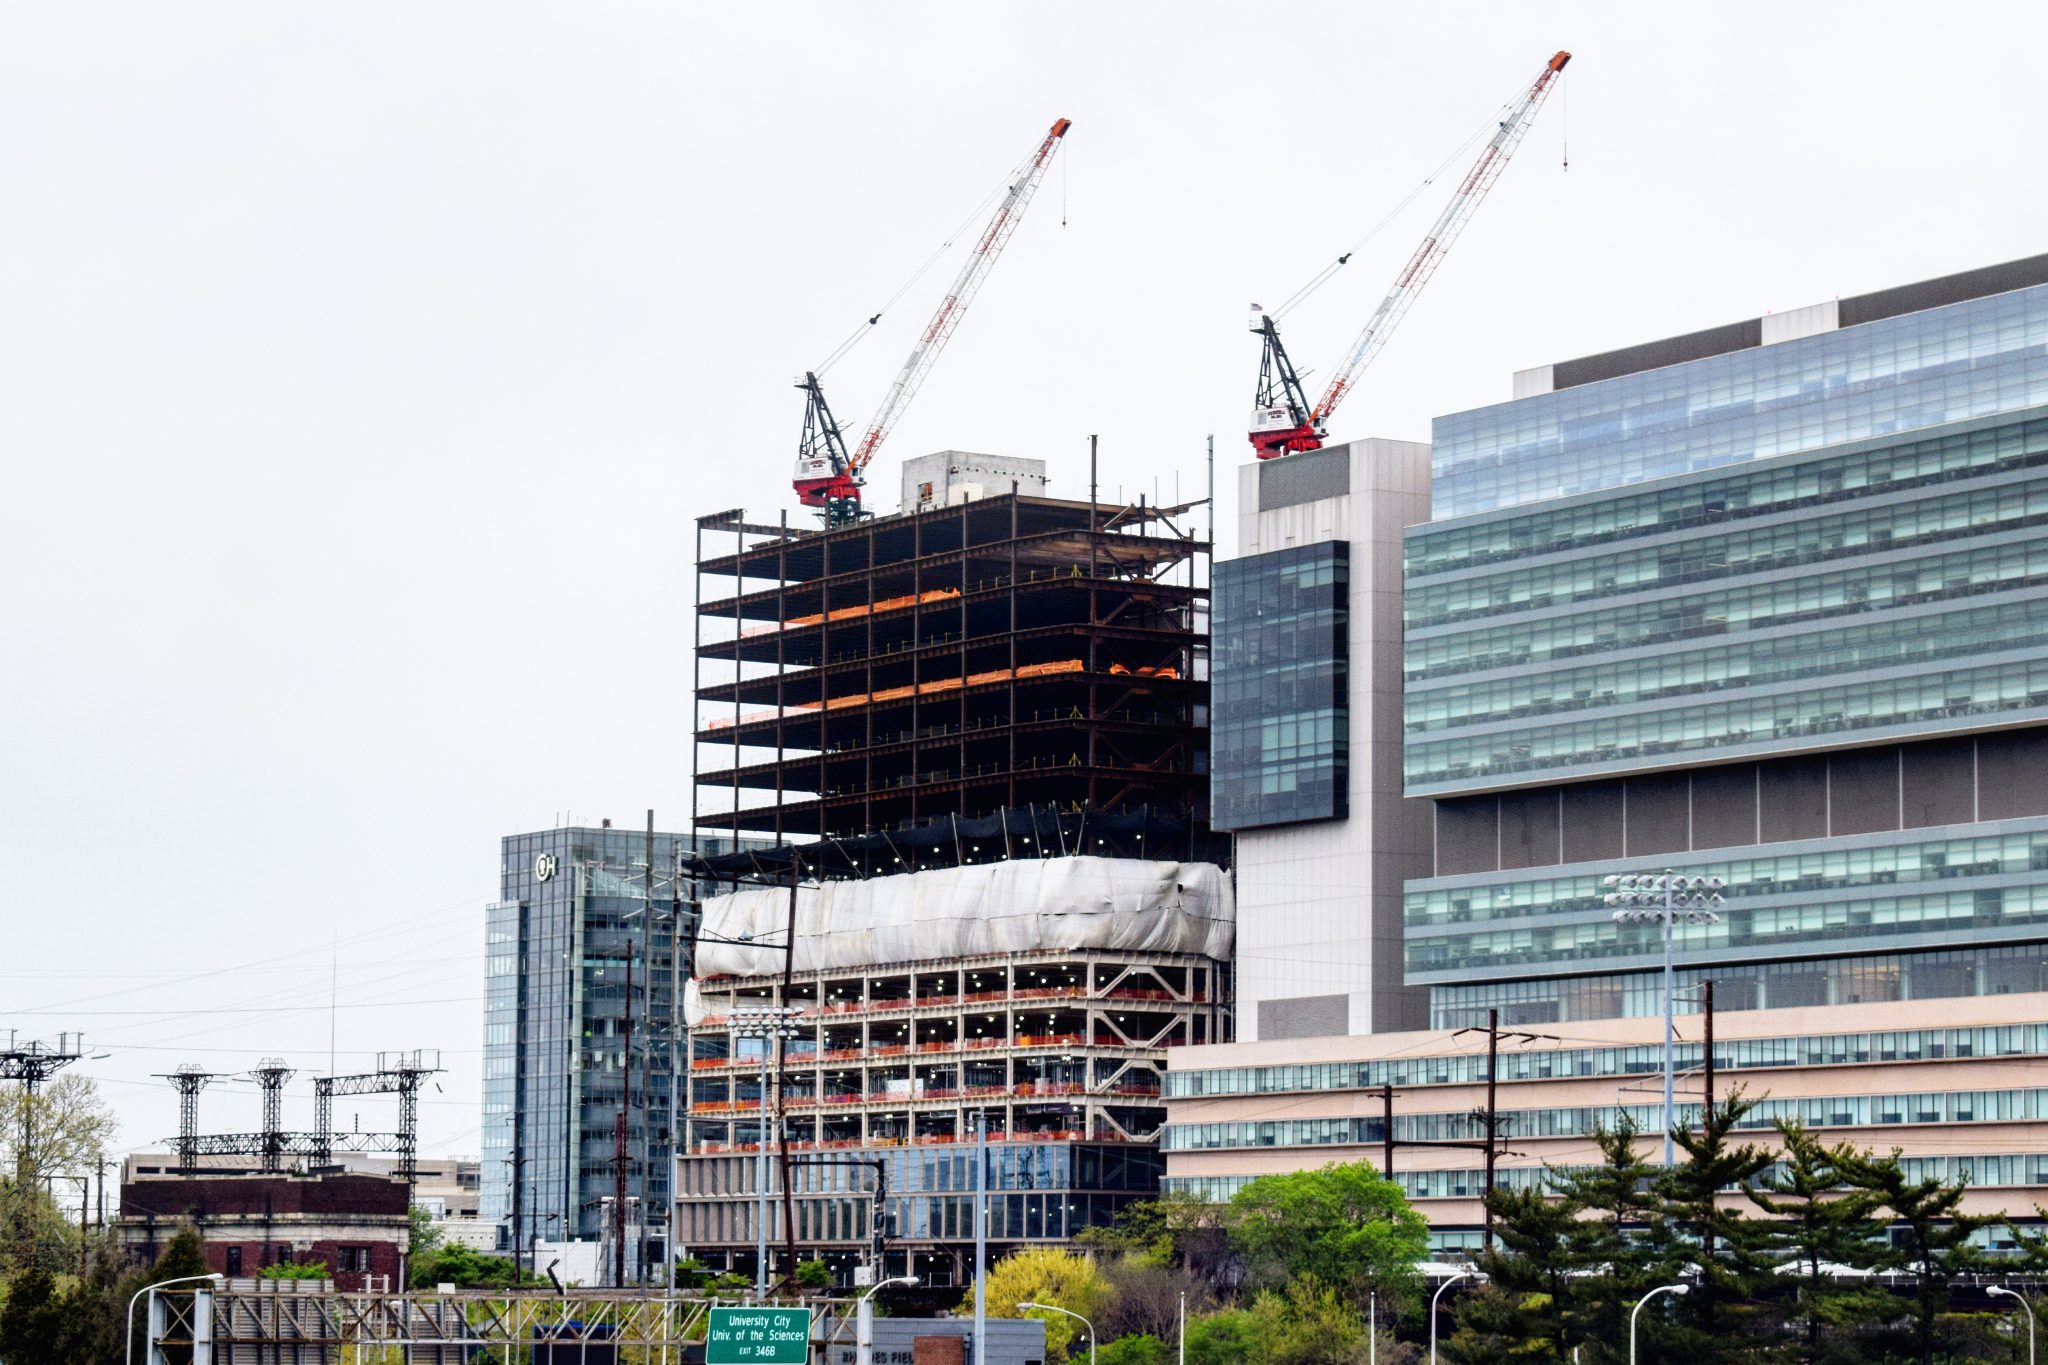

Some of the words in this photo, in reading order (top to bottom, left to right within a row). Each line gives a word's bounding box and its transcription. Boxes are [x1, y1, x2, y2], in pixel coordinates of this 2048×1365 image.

[729, 1315, 769, 1329] University
[774, 1315, 791, 1329] City
[712, 1329, 731, 1341] Univ.
[736, 1329, 745, 1341] of
[750, 1329, 764, 1341] the
[769, 1329, 805, 1341] Sciences
[739, 1347, 751, 1355] EXIT
[755, 1345, 776, 1357] 346B
[842, 1351, 888, 1363] RHES
[891, 1351, 914, 1364] FIEL
